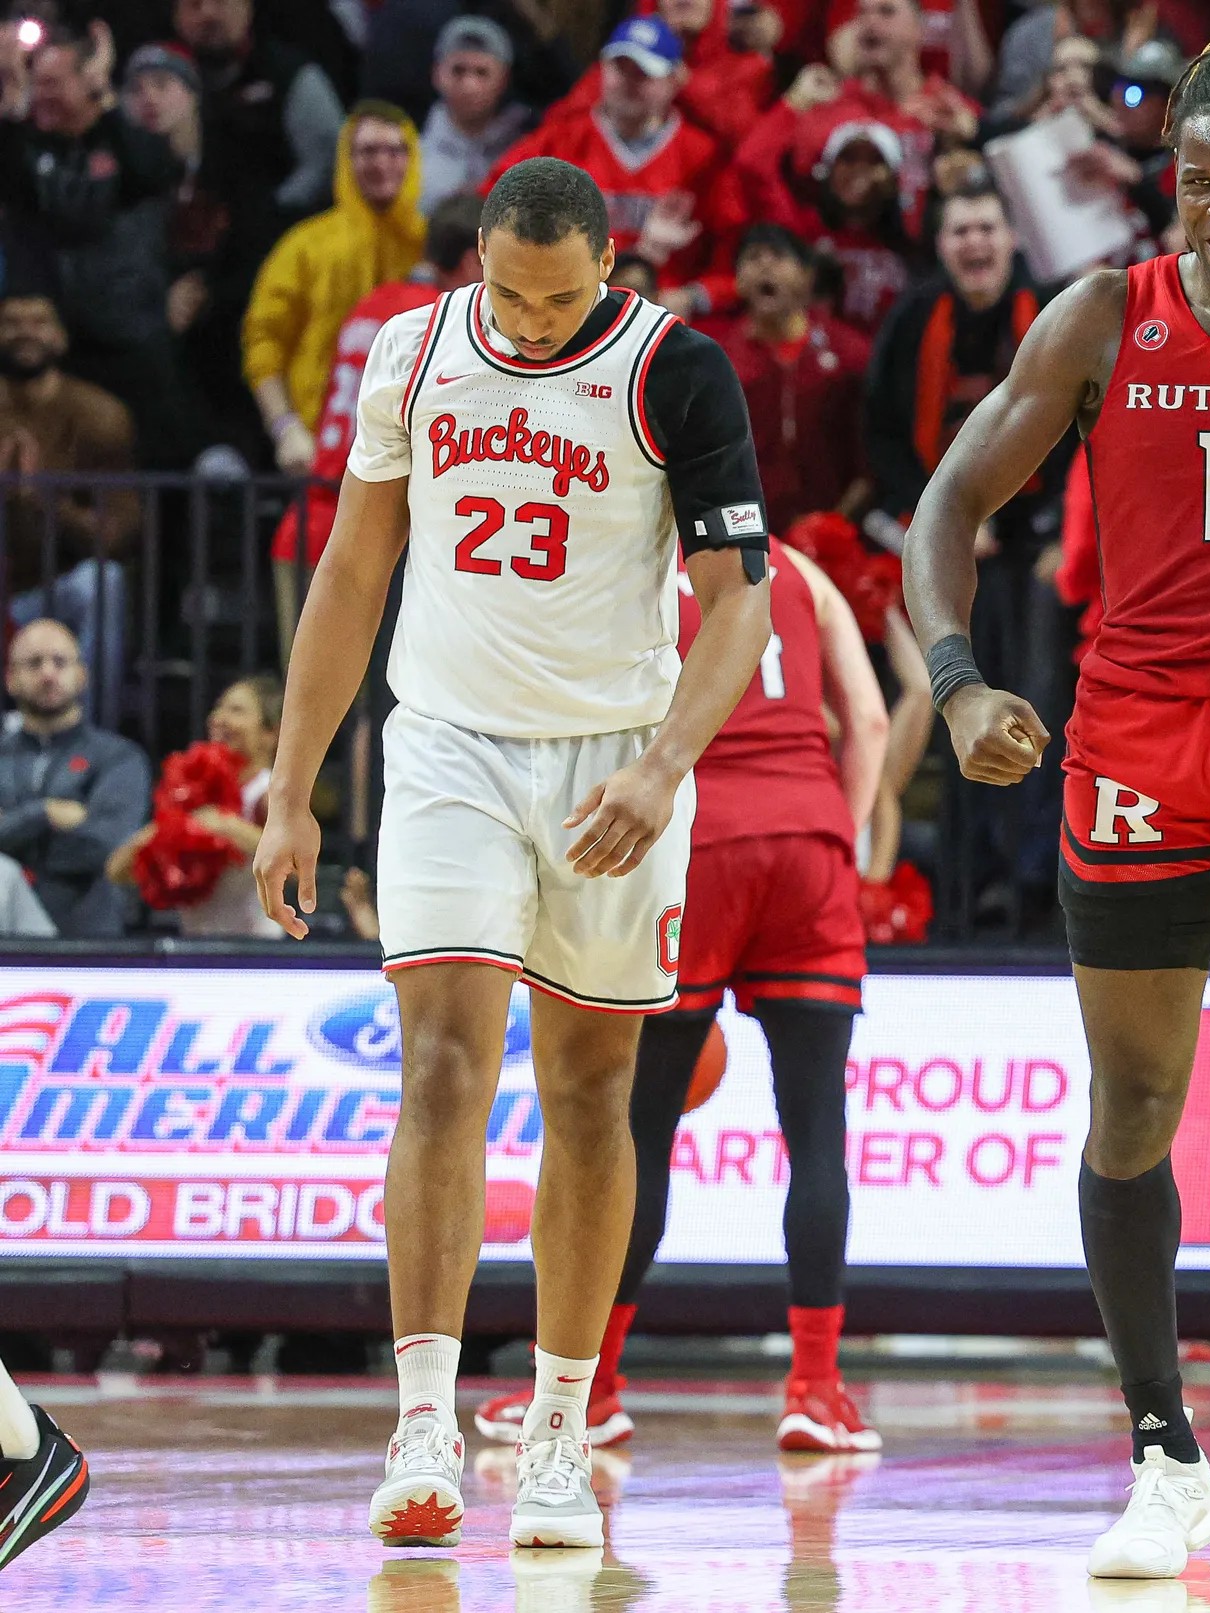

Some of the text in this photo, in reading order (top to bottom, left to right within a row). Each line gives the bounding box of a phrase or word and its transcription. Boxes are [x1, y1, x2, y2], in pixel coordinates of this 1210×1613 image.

[429, 407, 610, 497] Buckeyes
[454, 495, 570, 582] 23
[730, 510, 757, 526] Sully
[1090, 776, 1163, 844] R
[51, 1000, 295, 1074] ALL
[0, 1066, 543, 1143] MERICN
[966, 1132, 1064, 1187] OF
[0, 1181, 151, 1239] OLD
[1139, 1420, 1168, 1430] adidas
